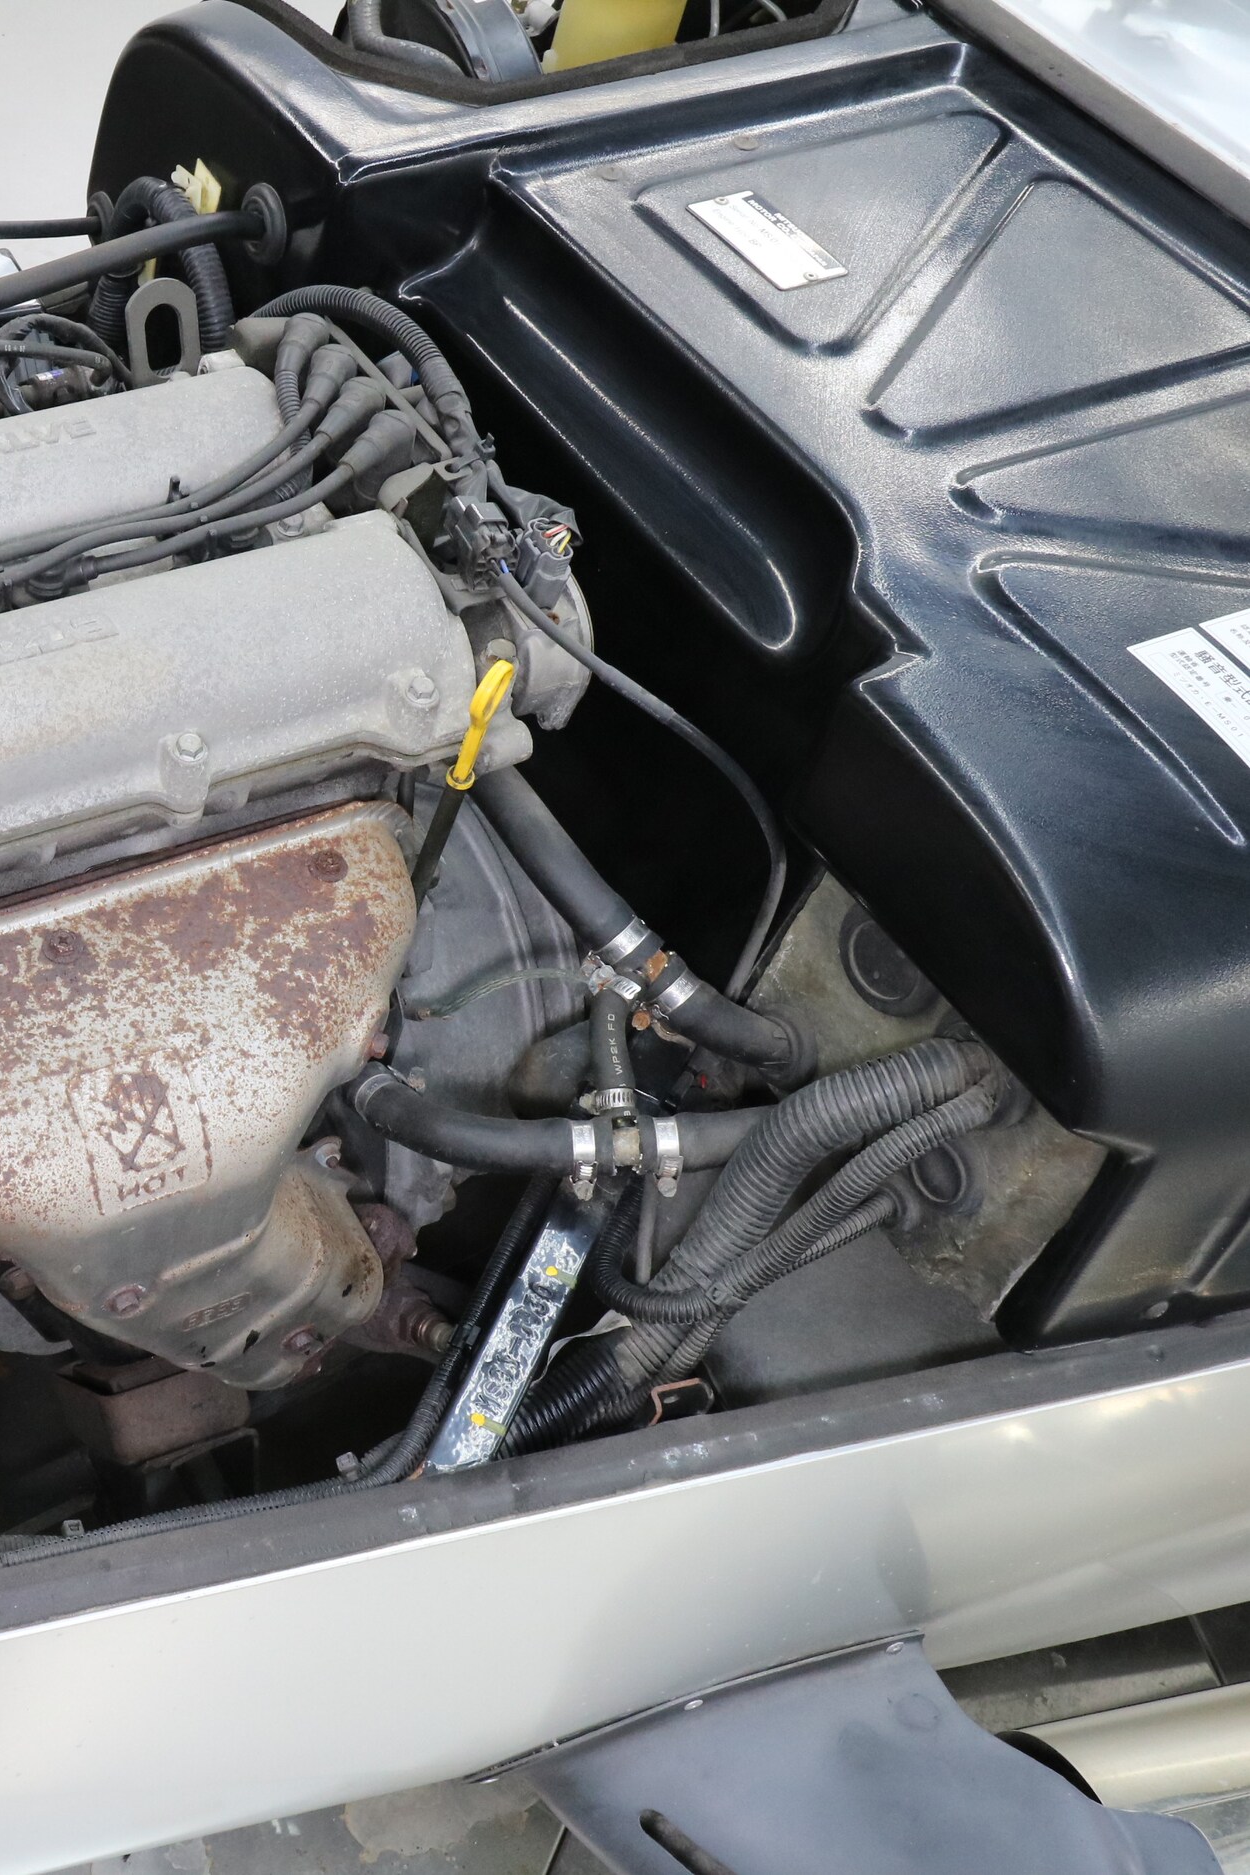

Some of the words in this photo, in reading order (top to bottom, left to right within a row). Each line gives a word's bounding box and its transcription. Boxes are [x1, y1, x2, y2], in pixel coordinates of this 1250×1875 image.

[747, 199, 778, 222] MOTOR
[607, 1013, 616, 1031] FD
[608, 1037, 623, 1076] WP2K
[111, 1163, 188, 1202] HOT
